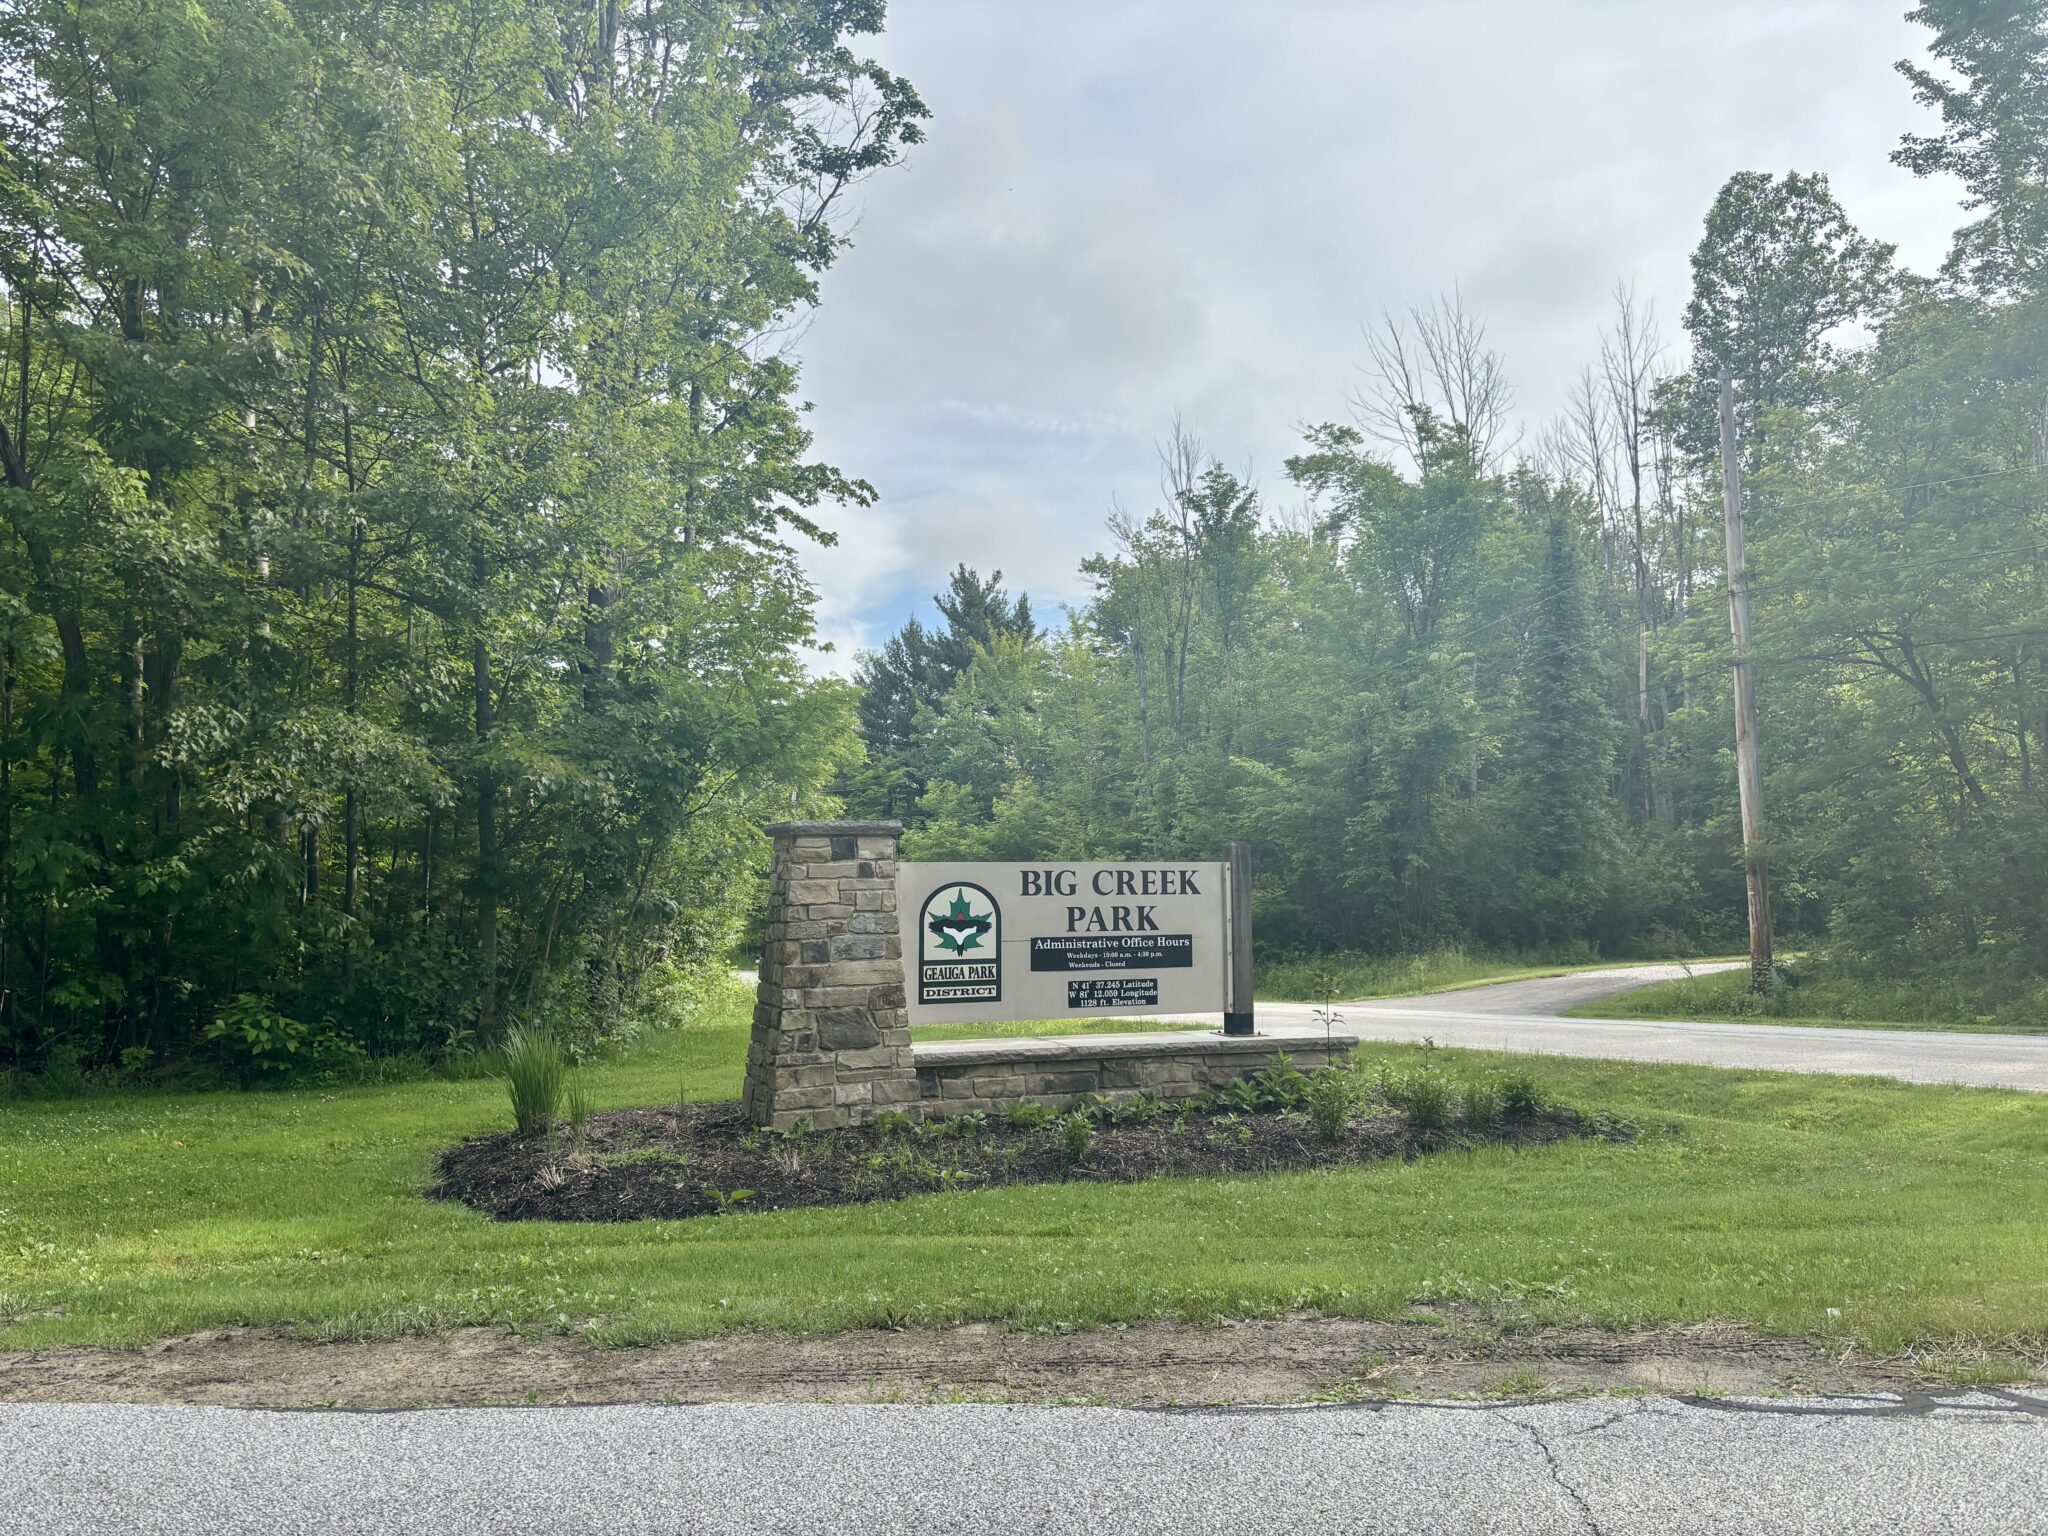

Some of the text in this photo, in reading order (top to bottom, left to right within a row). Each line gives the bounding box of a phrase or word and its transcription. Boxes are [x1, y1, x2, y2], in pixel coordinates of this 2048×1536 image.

[1020, 870, 1201, 896] BIG CREEK
[1066, 906, 1160, 932] PARK
[1035, 937, 1190, 949] Administrative Office Hours
[925, 966, 995, 980] GEAUGA PARK
[1095, 981, 1120, 989] 37.245
[1123, 980, 1154, 988] Latitude
[925, 987, 995, 997] DISTRICT
[1069, 991, 1077, 999] W
[1121, 988, 1157, 998] Longitude
[1080, 999, 1097, 1007] 1128
[1112, 997, 1147, 1006] Elevation
